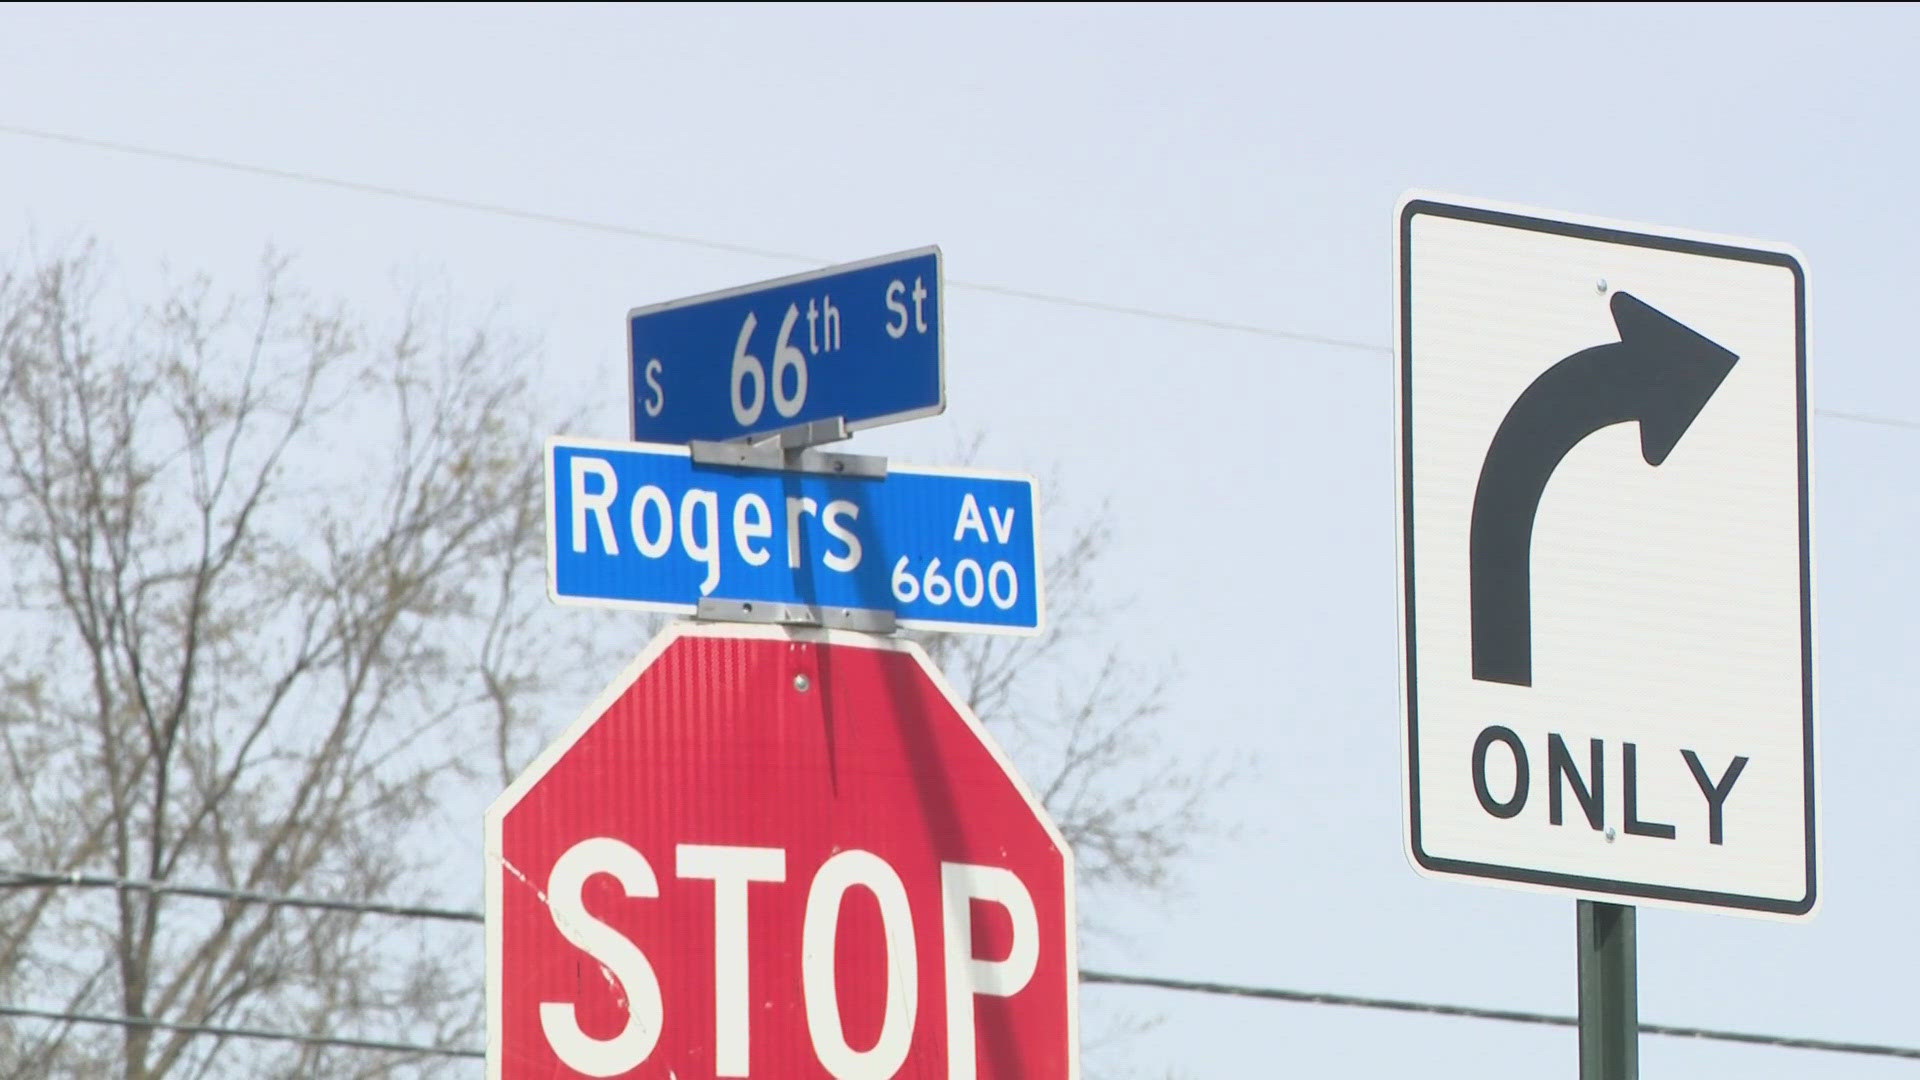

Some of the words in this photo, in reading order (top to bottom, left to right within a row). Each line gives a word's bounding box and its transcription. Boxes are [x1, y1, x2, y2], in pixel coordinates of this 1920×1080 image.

[644, 358, 664, 418] S
[730, 294, 842, 427] 66th
[885, 275, 928, 339] St
[569, 455, 863, 598] Rogers
[952, 493, 1015, 545] Av
[891, 555, 1019, 610] 6600
[1471, 725, 1750, 846] ONLY
[539, 836, 1040, 1080] STOP
